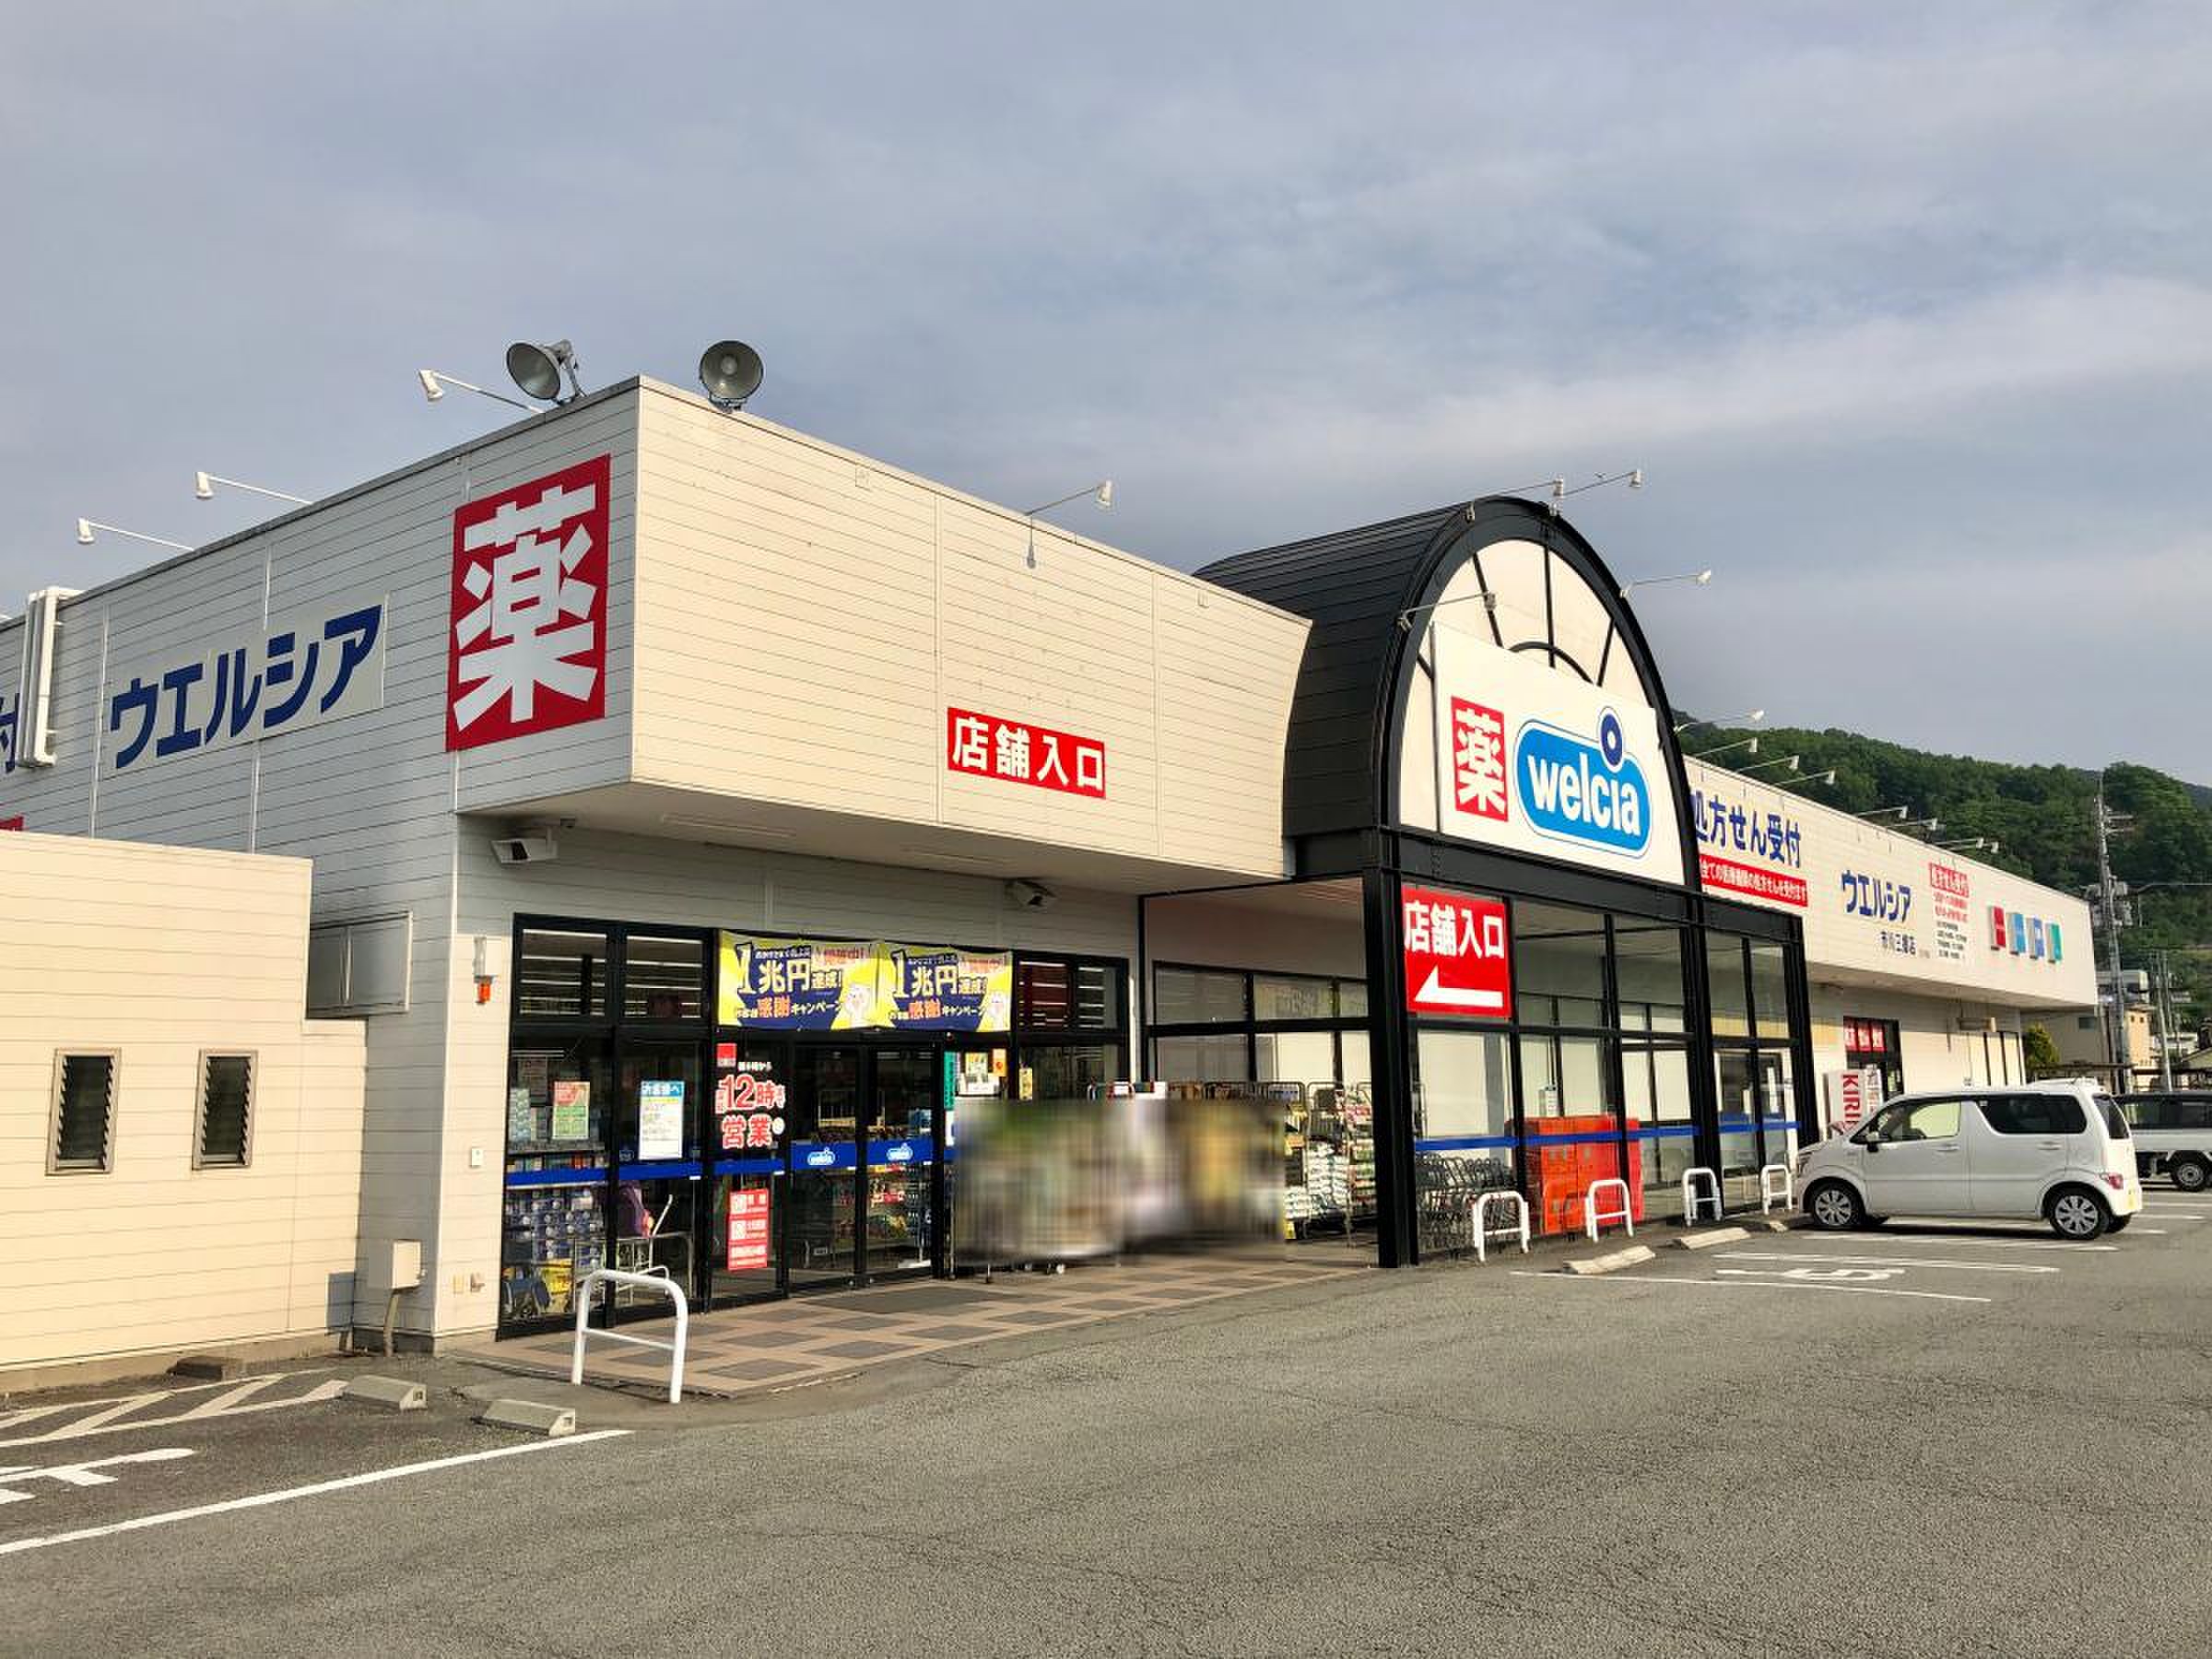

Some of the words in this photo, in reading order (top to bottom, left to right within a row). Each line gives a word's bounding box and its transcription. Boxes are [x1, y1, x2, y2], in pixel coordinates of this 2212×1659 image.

[454, 484, 596, 732] 薬
[110, 605, 382, 770] ウエルシア
[952, 716, 1103, 791] 店舗入口
[1456, 709, 1505, 814] 薬
[1526, 752, 1641, 837] welcia
[1404, 901, 1504, 959] 店舗入口
[1841, 869, 1911, 923] ウエルシア
[1841, 1073, 1861, 1125] KIRI
